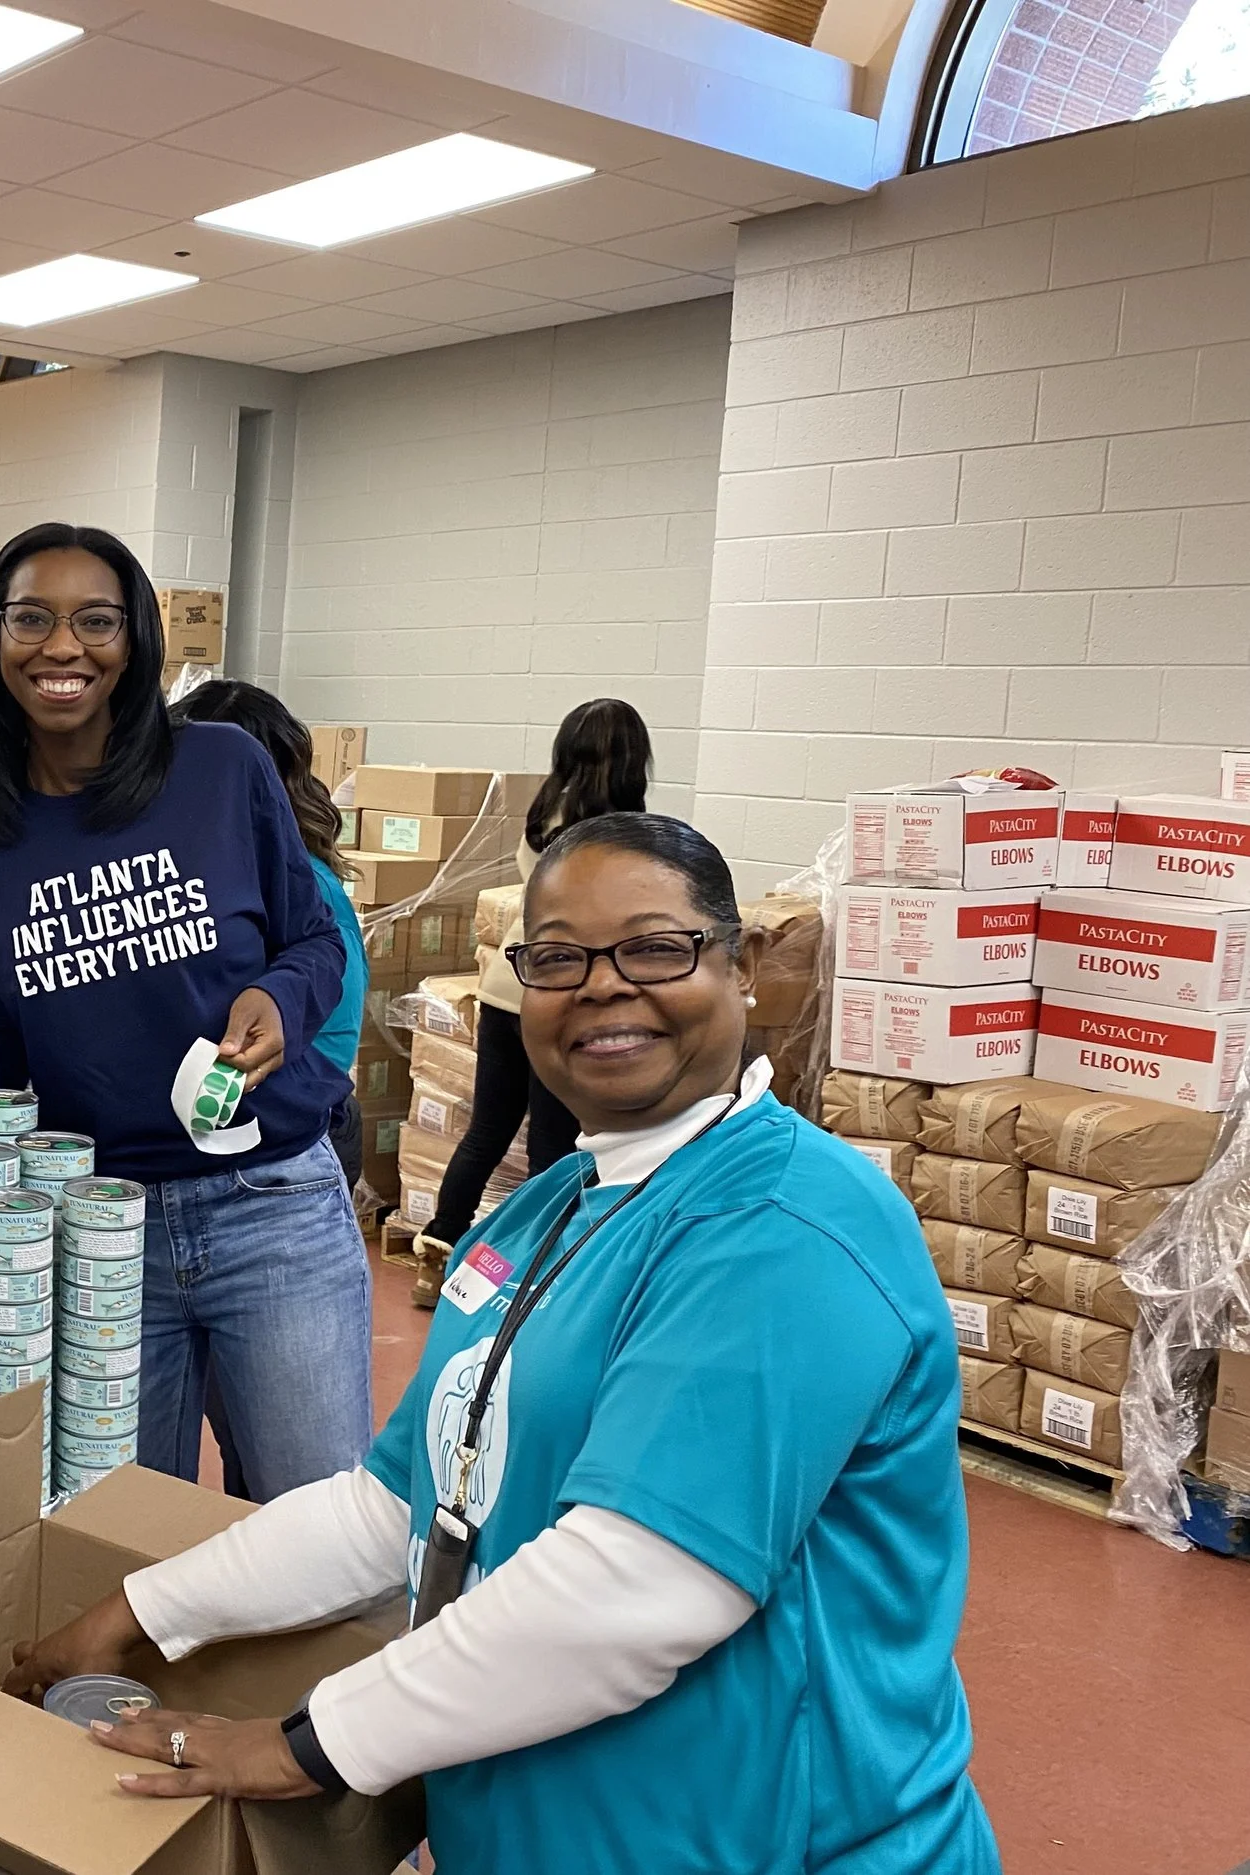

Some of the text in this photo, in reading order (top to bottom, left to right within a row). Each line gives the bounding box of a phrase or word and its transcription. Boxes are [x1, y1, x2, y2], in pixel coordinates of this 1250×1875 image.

[991, 848, 1034, 865] ELBOWS
[1087, 850, 1112, 865] ELBO
[1157, 855, 1235, 878] ELBOWS
[29, 849, 179, 916] ATLANTA
[12, 878, 208, 959] INFLUENCES
[898, 911, 927, 920] ELBOWS
[15, 916, 218, 997] EVERYTHING
[983, 943, 1026, 961] ELBOWS
[1078, 953, 1160, 980] ELBOWS
[891, 1006, 920, 1016] ELBOWS
[976, 1039, 1021, 1058] ELBOWS
[1080, 1049, 1160, 1079] ELBOWS
[478, 1251, 503, 1274] HELLO
